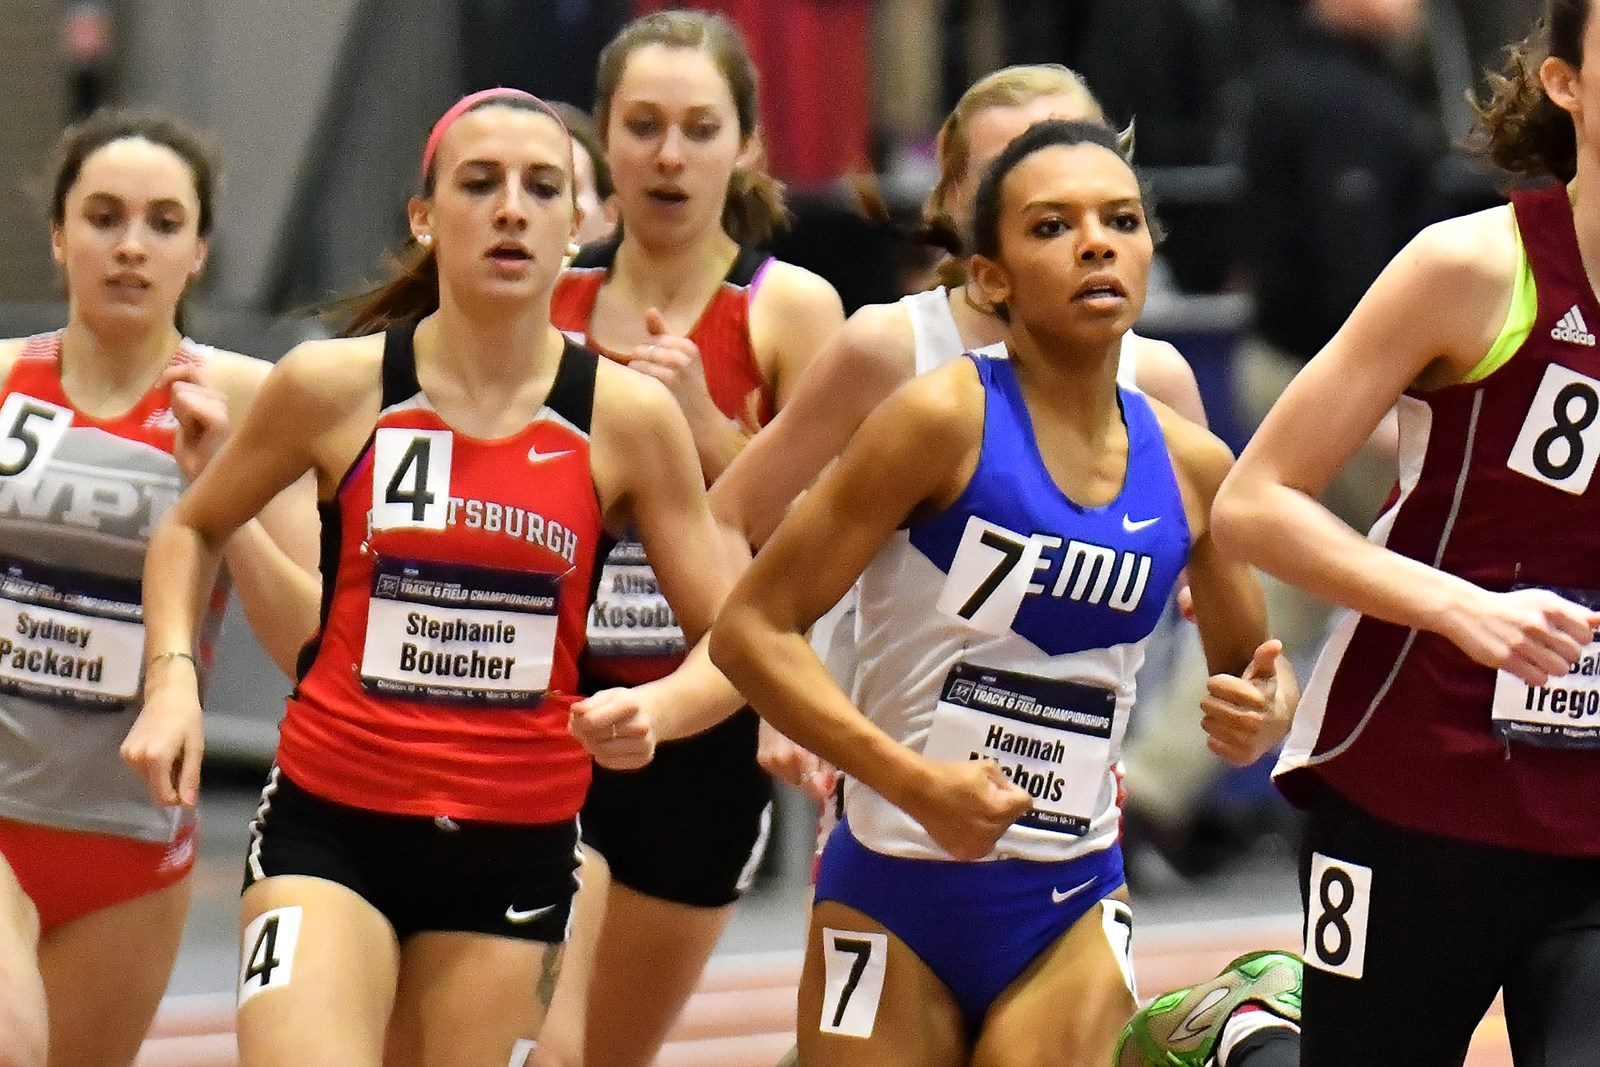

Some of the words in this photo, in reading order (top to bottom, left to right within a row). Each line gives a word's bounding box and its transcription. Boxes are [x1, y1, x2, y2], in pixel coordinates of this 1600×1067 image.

[1551, 327, 1596, 347] adidas
[0, 402, 56, 476] 5
[1532, 381, 1600, 480] 8
[385, 436, 435, 522] 4
[366, 496, 578, 564] TSBURGH
[401, 581, 432, 597] TRACK
[441, 587, 468, 600] FIELD
[470, 590, 555, 608] CHAMPIONSHIPS
[956, 529, 1026, 620] 7
[1025, 533, 1152, 613] EMU
[16, 611, 91, 648] Sydney
[406, 611, 516, 643] Stephanie
[593, 601, 678, 628] Kosob
[0, 637, 103, 682] Packard
[399, 642, 516, 680] Boucher
[973, 688, 1006, 707] TRACK
[1006, 697, 1016, 709] &
[1014, 700, 1043, 716] FIELD
[1042, 705, 1110, 730] CHAMPIONSHIPS
[985, 724, 1066, 763] Hannah
[1038, 812, 1058, 823] March
[1315, 866, 1354, 966] 8
[244, 914, 281, 986] 4
[832, 937, 872, 1027] 7
